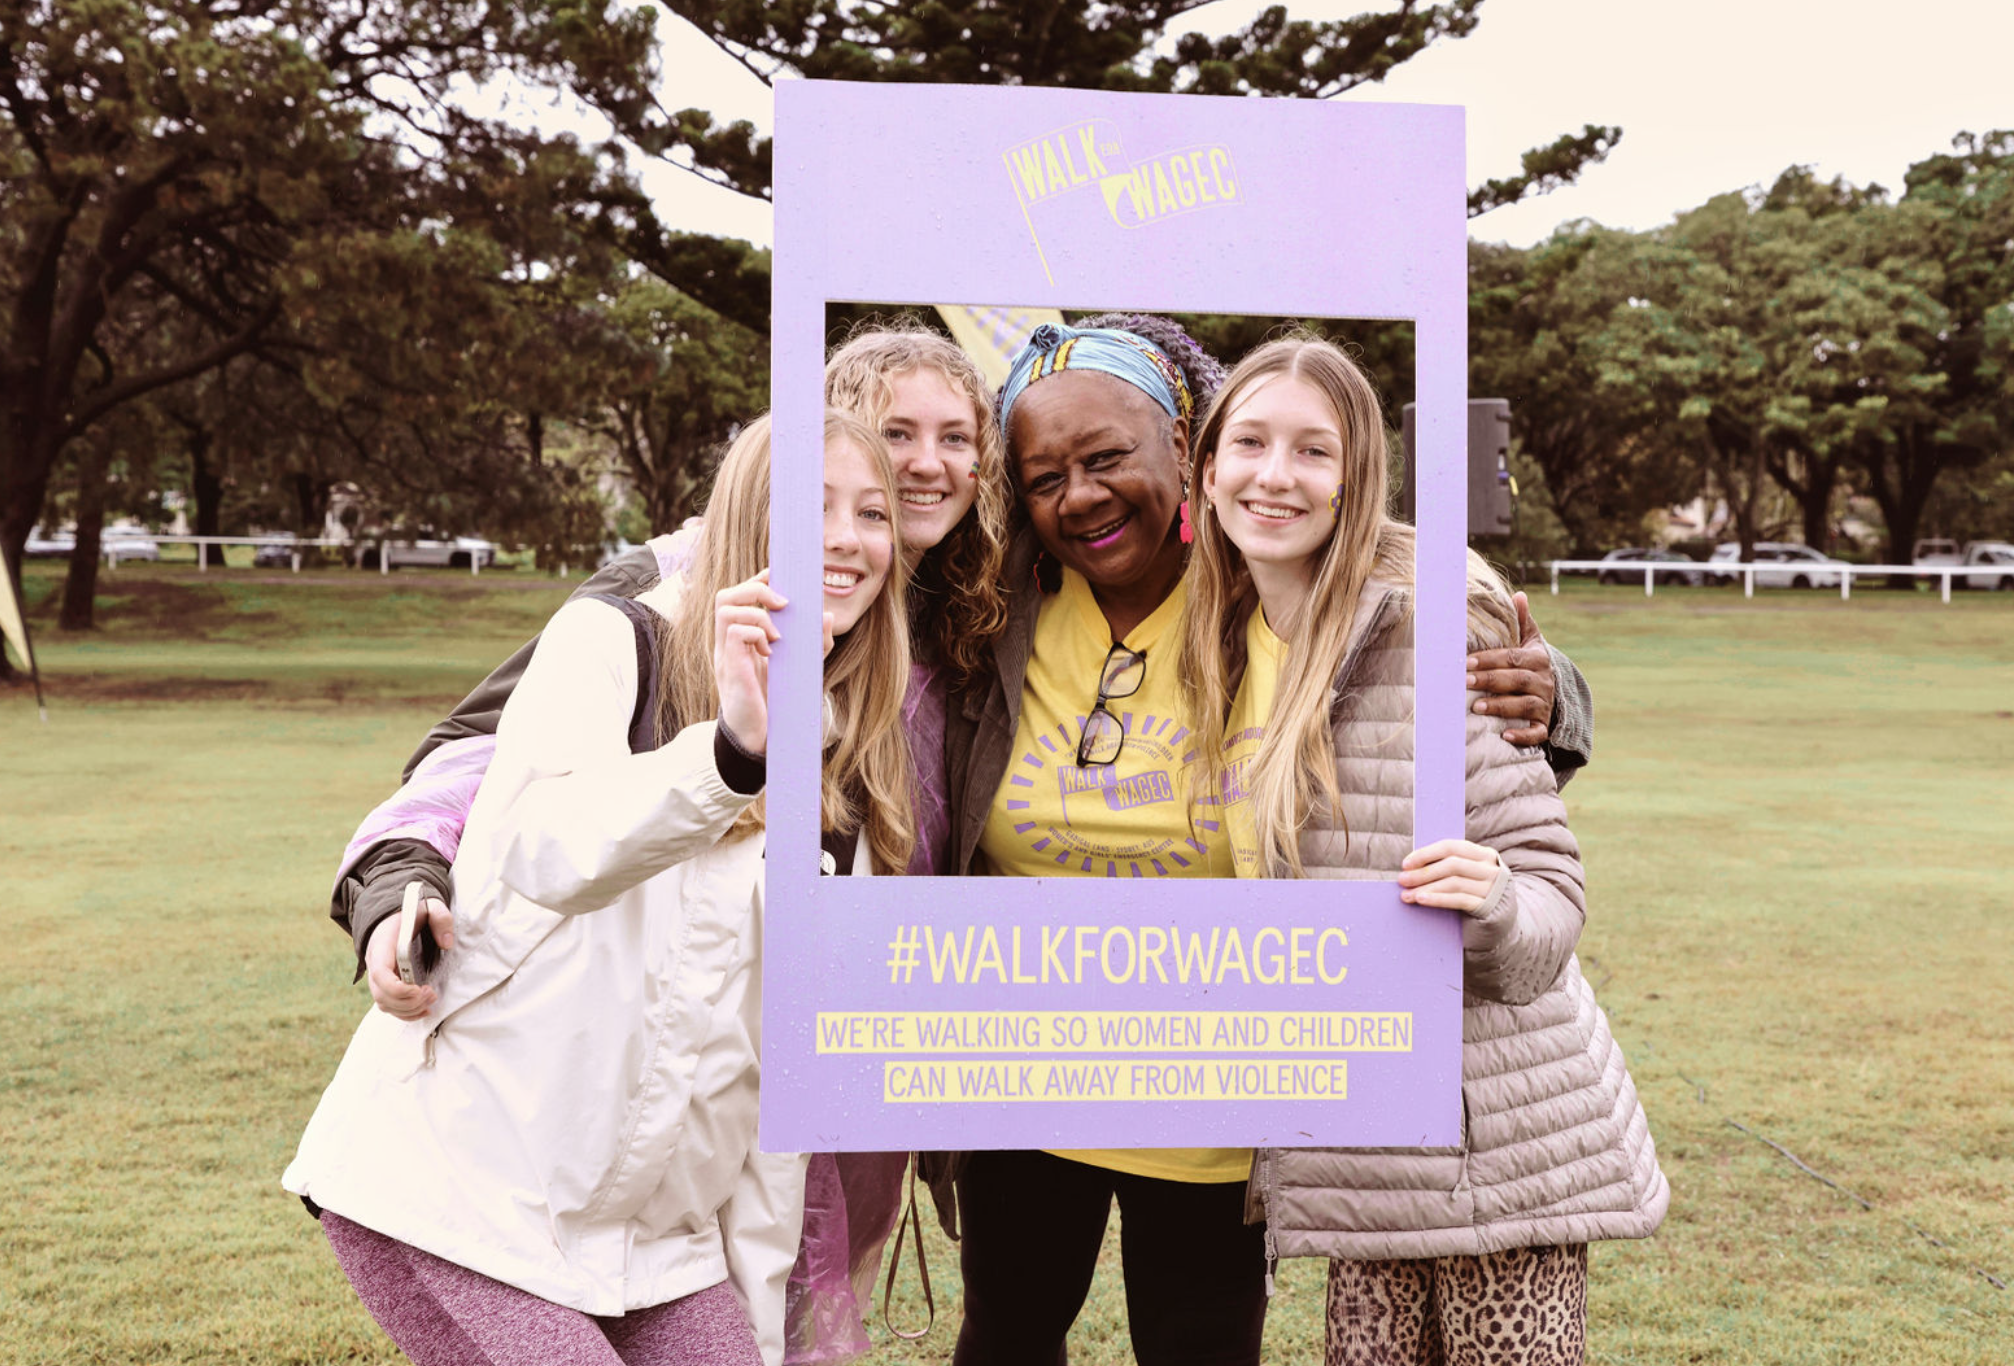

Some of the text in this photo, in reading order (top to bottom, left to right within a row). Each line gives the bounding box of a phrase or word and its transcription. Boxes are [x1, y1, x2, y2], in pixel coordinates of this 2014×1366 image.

[1011, 124, 1109, 200] WALK
[1126, 147, 1236, 220] WAGEC
[1062, 767, 1107, 793] WALK
[1115, 772, 1171, 808] WAGEC
[886, 925, 1349, 986] #WALKFORWAGEC
[821, 1016, 1409, 1048] WE'RE WALKING SO WOMEN AND CHILDREN
[889, 1064, 1343, 1097] CAN WALK AWAY FROM VIOLENCE
